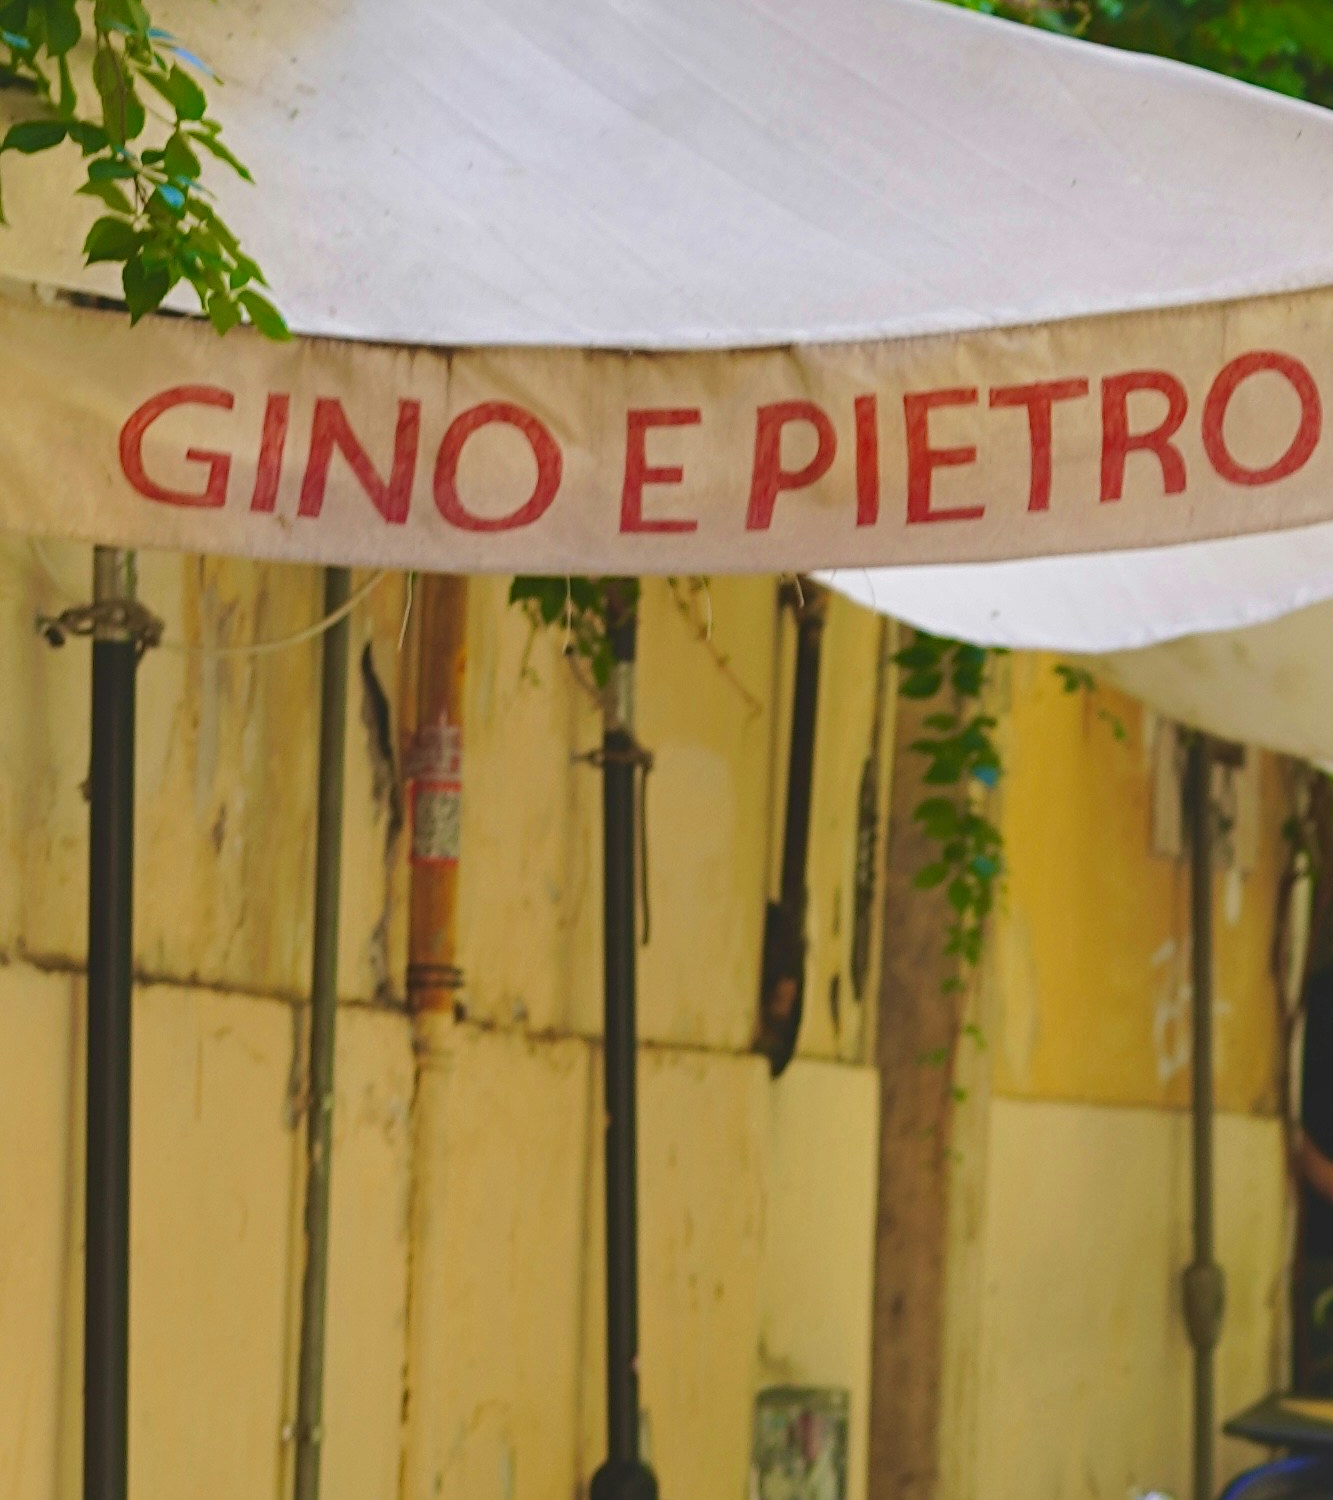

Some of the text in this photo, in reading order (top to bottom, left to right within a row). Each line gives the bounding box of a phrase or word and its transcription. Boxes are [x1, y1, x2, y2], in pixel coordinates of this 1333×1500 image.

[118, 350, 1324, 535] GINO E PIETRO
